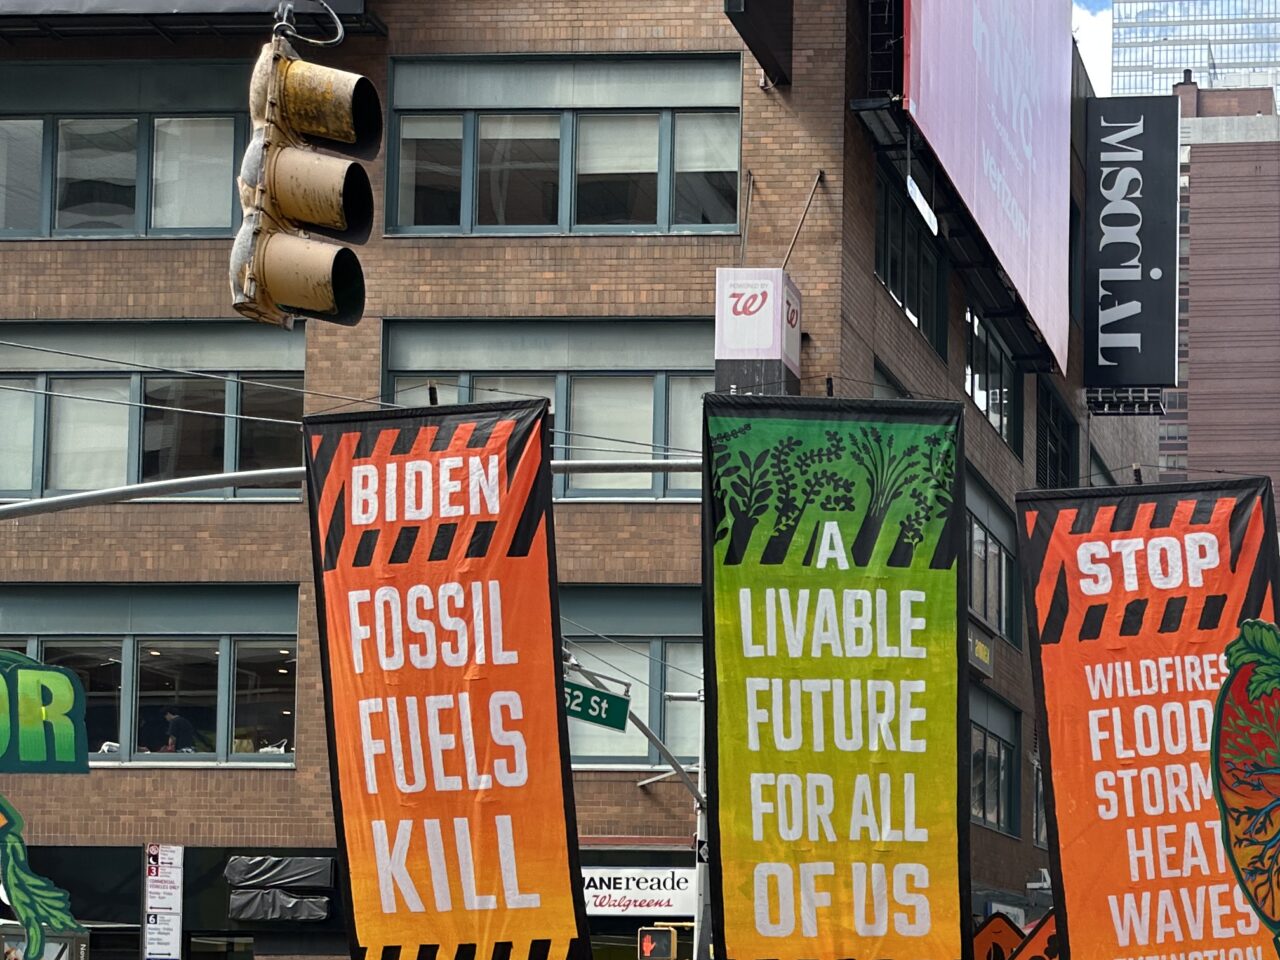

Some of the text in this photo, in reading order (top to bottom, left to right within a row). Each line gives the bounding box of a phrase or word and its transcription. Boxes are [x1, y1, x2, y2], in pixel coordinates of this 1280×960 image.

[981, 138, 1030, 242] verizon
[351, 455, 500, 525] BIDEN
[816, 521, 849, 569] A
[1076, 532, 1219, 596] STOP
[348, 580, 518, 674] FOSSIL
[739, 588, 926, 658] LIVABLE
[588, 696, 608, 718] St
[1084, 653, 1229, 700] WILDFIRES
[358, 691, 528, 795] FUELS
[747, 677, 927, 752] FUTURE
[1087, 700, 1212, 761] FLOOD
[750, 773, 929, 842] FOR ALL
[1094, 761, 1218, 821] STORM
[150, 867, 157, 876] 3
[372, 815, 541, 914] KILL
[1127, 819, 1226, 883] HEAT
[149, 915, 156, 924] 6
[592, 894, 673, 912] Walgreens
[753, 861, 931, 939] OF US
[1107, 882, 1259, 947] WAVES
